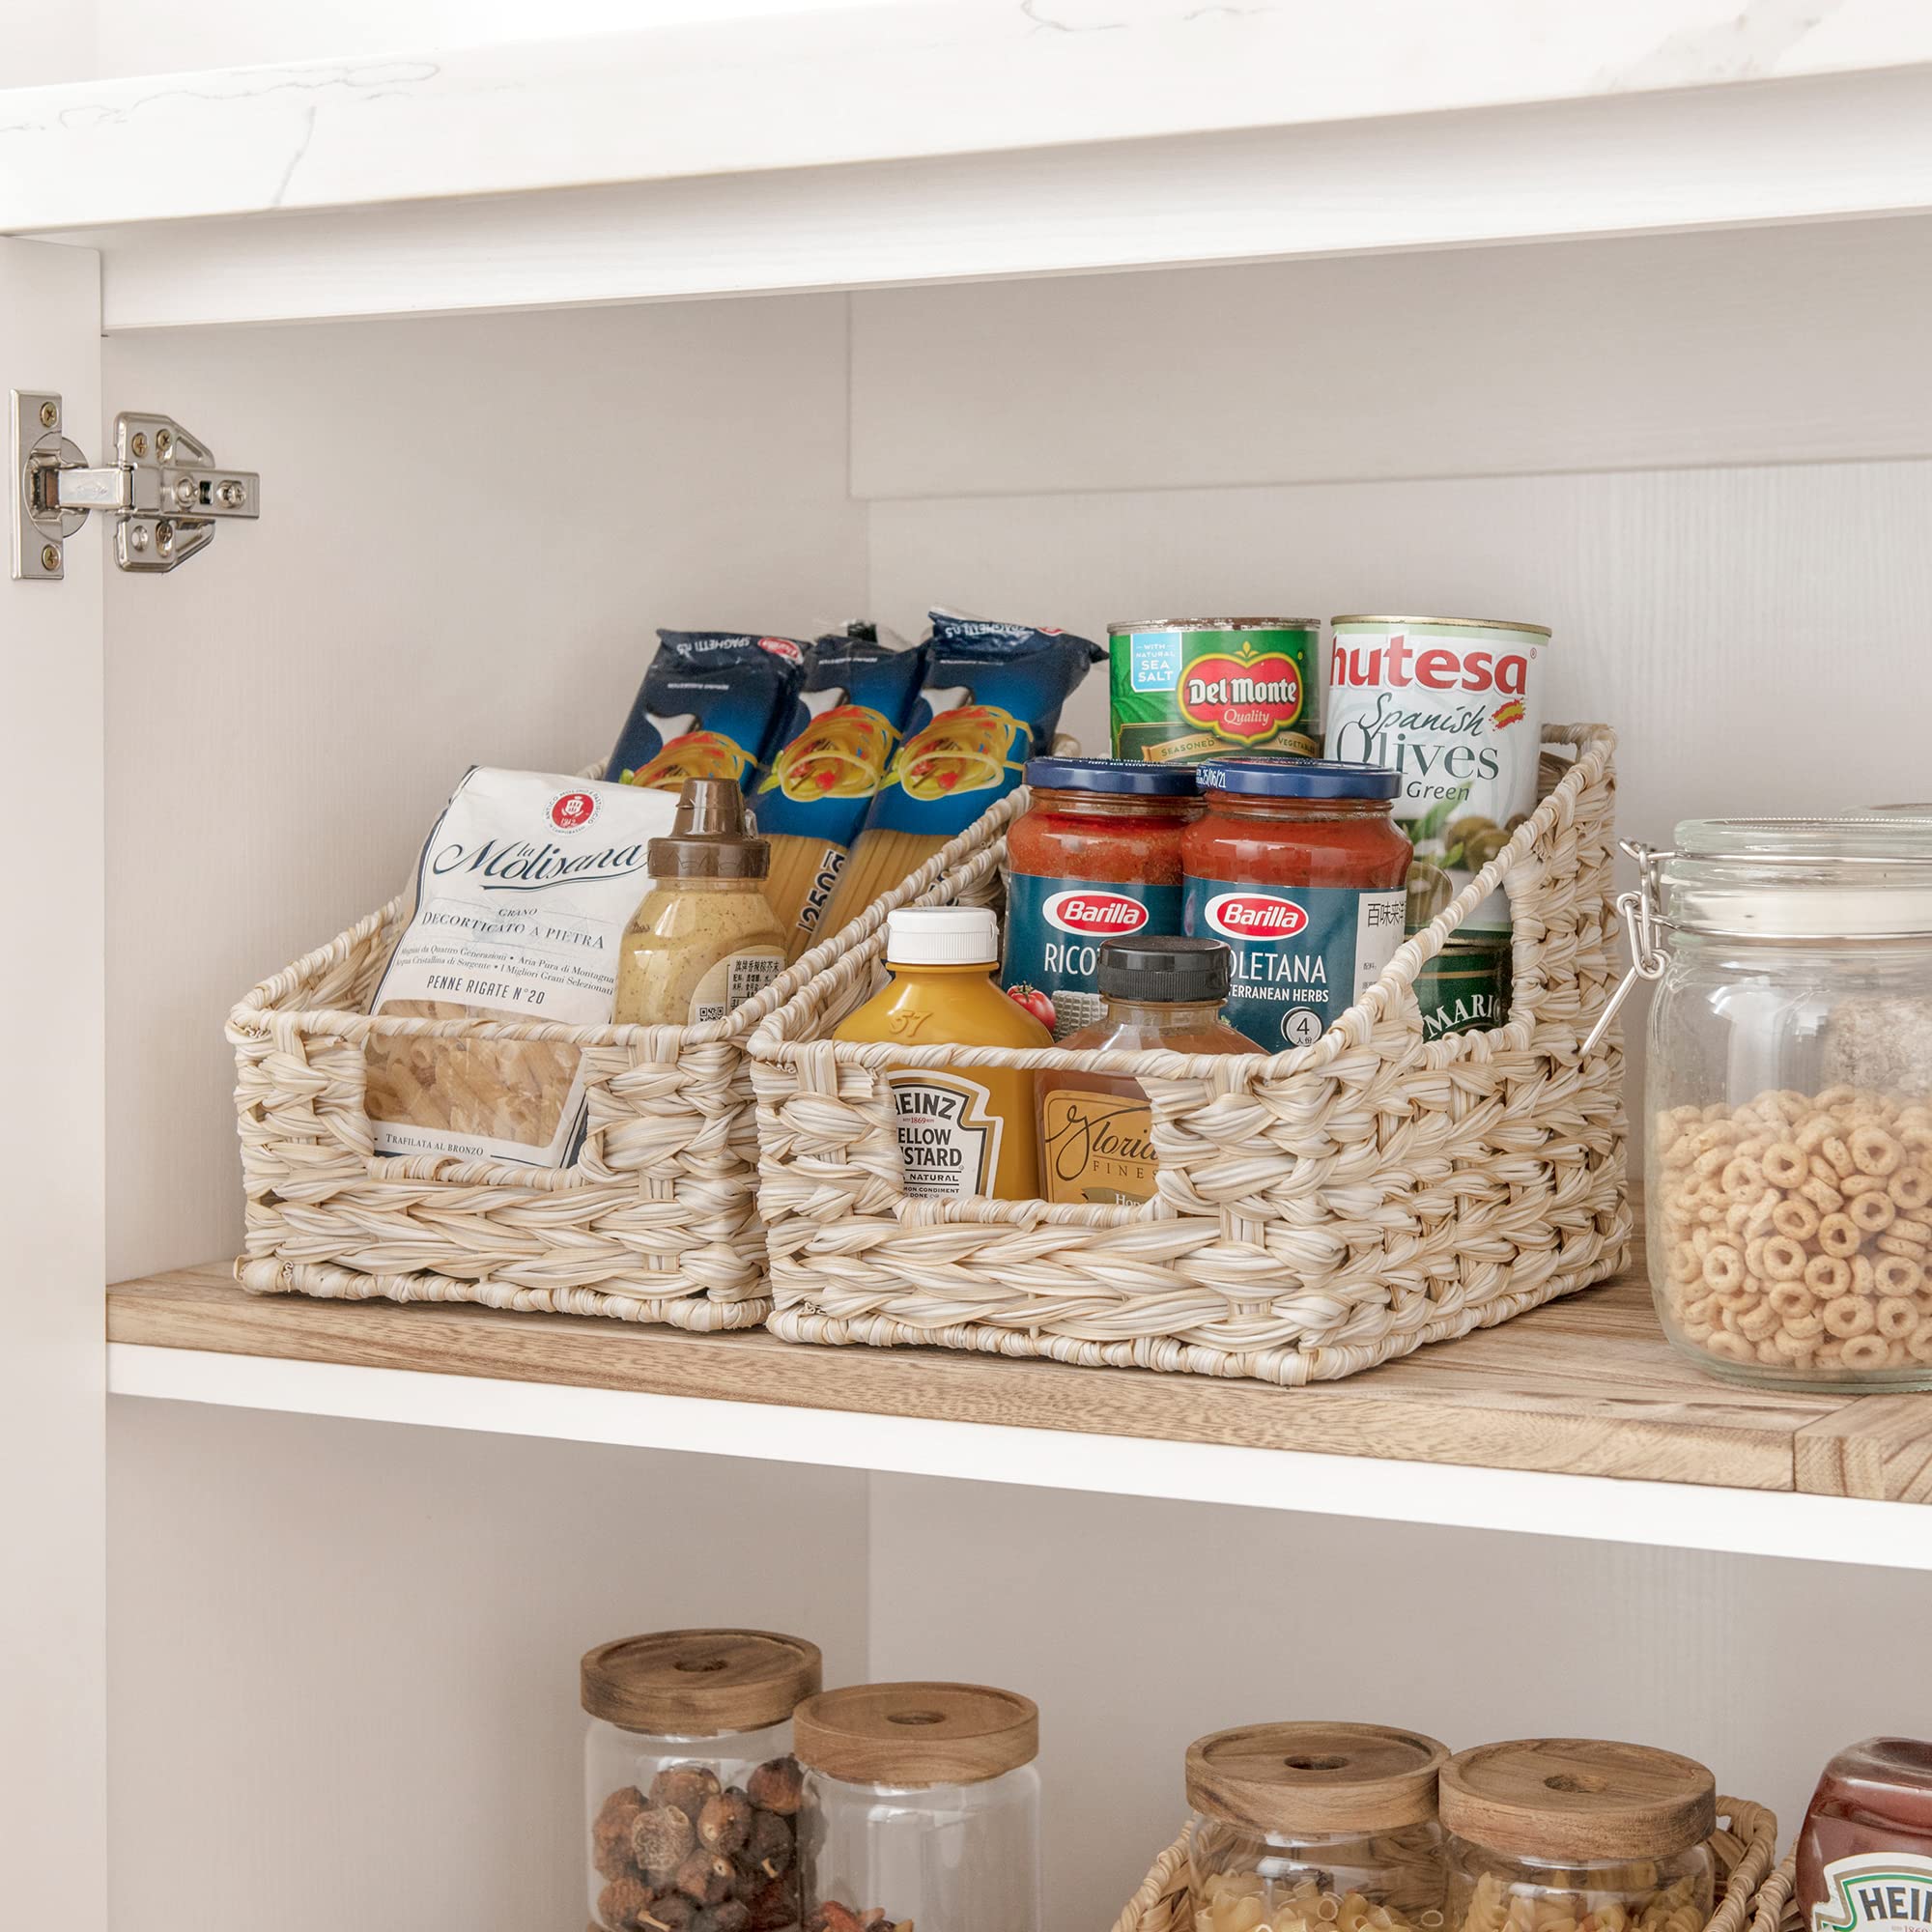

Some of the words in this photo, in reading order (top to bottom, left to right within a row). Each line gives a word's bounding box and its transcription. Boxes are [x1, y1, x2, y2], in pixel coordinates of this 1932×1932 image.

[695, 637, 752, 652] SPAGHETTI
[1138, 670, 1174, 682] SALT
[1142, 660, 1170, 670] SEA
[1330, 635, 1527, 696] hutesa
[1188, 678, 1228, 705] Del
[1231, 678, 1297, 706] Monte
[1223, 709, 1270, 725] Quality
[1358, 692, 1487, 741] Spanish
[1161, 737, 1215, 757] SEASONED
[1336, 721, 1499, 781] Olives
[1406, 781, 1470, 801] Green
[432, 838, 649, 880] Molisana
[517, 842, 535, 857] la
[498, 908, 538, 917] GRANO
[1064, 900, 1140, 924] Barilla
[1223, 903, 1298, 927] Barilla
[422, 912, 526, 934] DECORTICATO
[530, 925, 540, 937] A
[546, 927, 604, 950] PIETRA
[430, 944, 459, 955] Quattro
[460, 947, 507, 961] Generazioni
[518, 956, 536, 967] Aria
[539, 959, 558, 972] Pura
[560, 962, 570, 973] di
[571, 966, 615, 984] Montagna
[1044, 943, 1100, 976] RICO
[412, 955, 445, 965] Cristallina
[446, 956, 456, 966] di
[457, 959, 491, 971] Sorgente
[506, 965, 538, 980] Migliori
[541, 972, 565, 984] Grani
[567, 976, 614, 997] Selezionati
[427, 975, 464, 992] PENNE
[466, 980, 509, 999] RIGATE
[1293, 988, 1329, 1003] HERBS
[889, 1009, 933, 1038] 57
[1295, 1017, 1310, 1036] 4
[385, 1133, 432, 1150] TRAFILATA
[434, 1142, 445, 1151] AL
[447, 1143, 484, 1156] BRONZO
[897, 1127, 952, 1146] ELLOW
[900, 1147, 962, 1167] STARD
